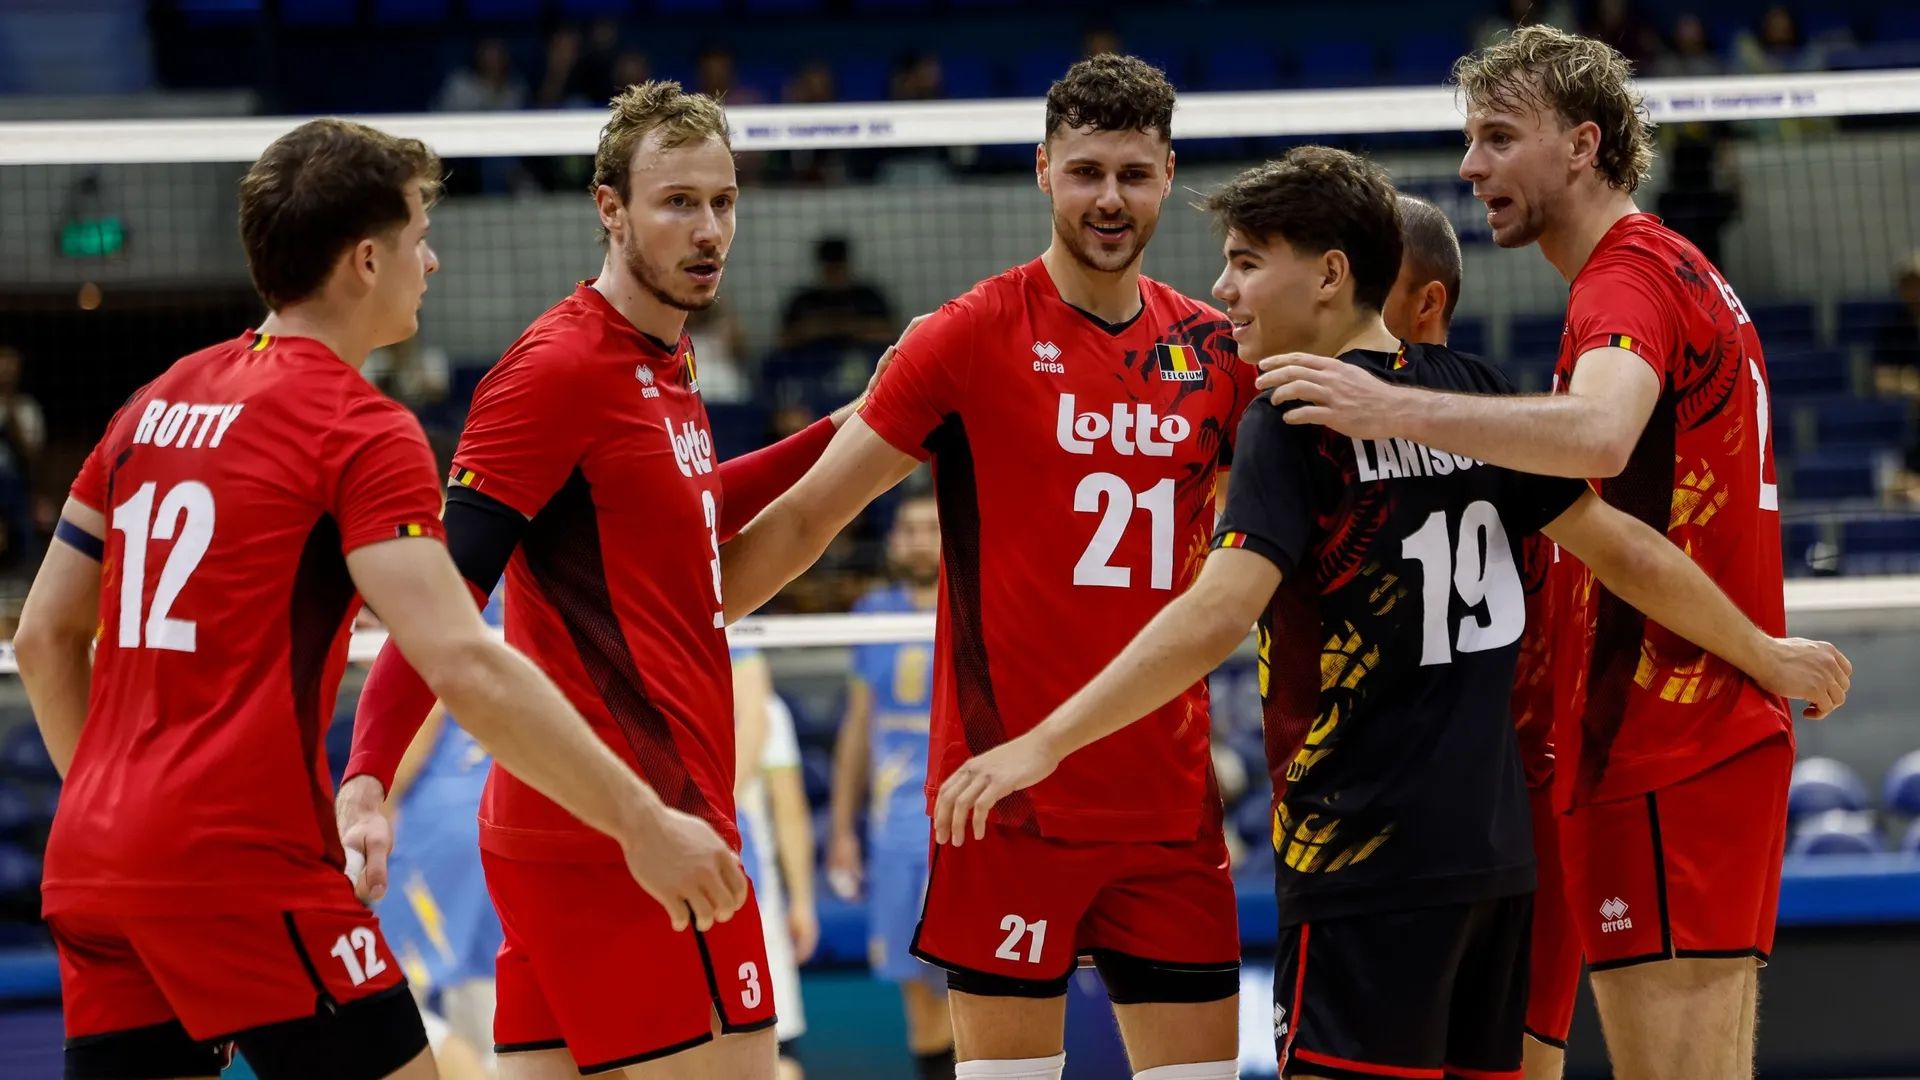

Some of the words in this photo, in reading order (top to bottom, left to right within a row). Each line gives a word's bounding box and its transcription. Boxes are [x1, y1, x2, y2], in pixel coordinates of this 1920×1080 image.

[1162, 371, 1203, 381] BELGIUM
[132, 399, 245, 449] ROTTY
[1073, 471, 1176, 591] 21
[111, 479, 216, 653] 12
[1401, 500, 1527, 667] 19
[330, 926, 388, 988] 12
[995, 914, 1048, 964] 21
[738, 961, 762, 1010] 3
